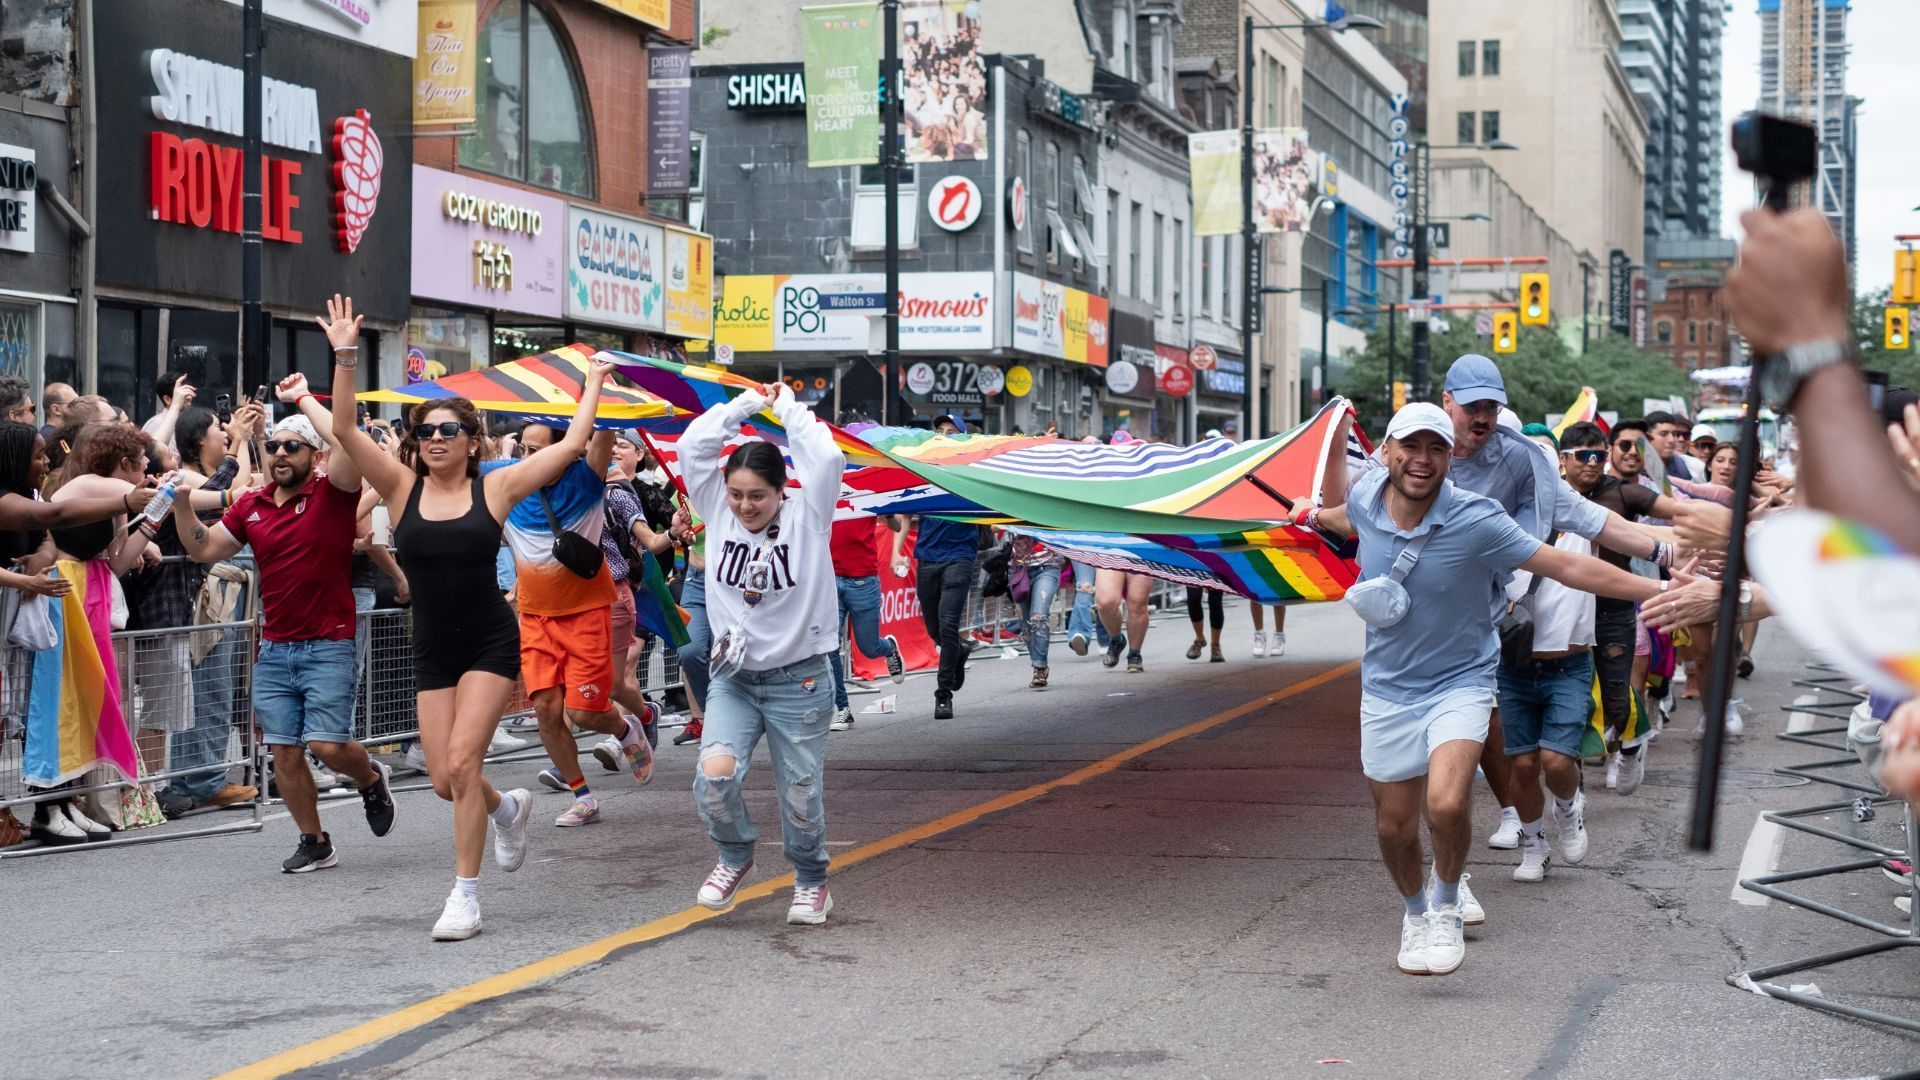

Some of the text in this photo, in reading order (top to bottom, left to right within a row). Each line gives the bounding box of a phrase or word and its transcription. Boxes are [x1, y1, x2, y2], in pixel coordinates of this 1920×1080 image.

[425, 33, 463, 51] Thai
[431, 55, 457, 74] On
[651, 54, 687, 76] pretty
[825, 66, 859, 79] MEET
[417, 81, 471, 104] Yonge
[728, 73, 806, 106] SHISHA
[844, 80, 858, 91] IN
[151, 48, 322, 154] SHAWRMA
[808, 91, 879, 106] TORONTO'S
[818, 104, 879, 118] CULTURAL
[814, 119, 854, 132] HEART
[152, 132, 303, 243] ROYLE
[446, 190, 542, 236] COZY GROTTO
[577, 219, 652, 282] CANADA
[591, 279, 641, 315] GIFTS
[713, 296, 769, 321] holic
[830, 296, 875, 307] Walton St
[936, 362, 979, 392] 372
[933, 393, 983, 403] FOOD HALL
[717, 540, 796, 590] TOY
[880, 588, 923, 624] ROGER
